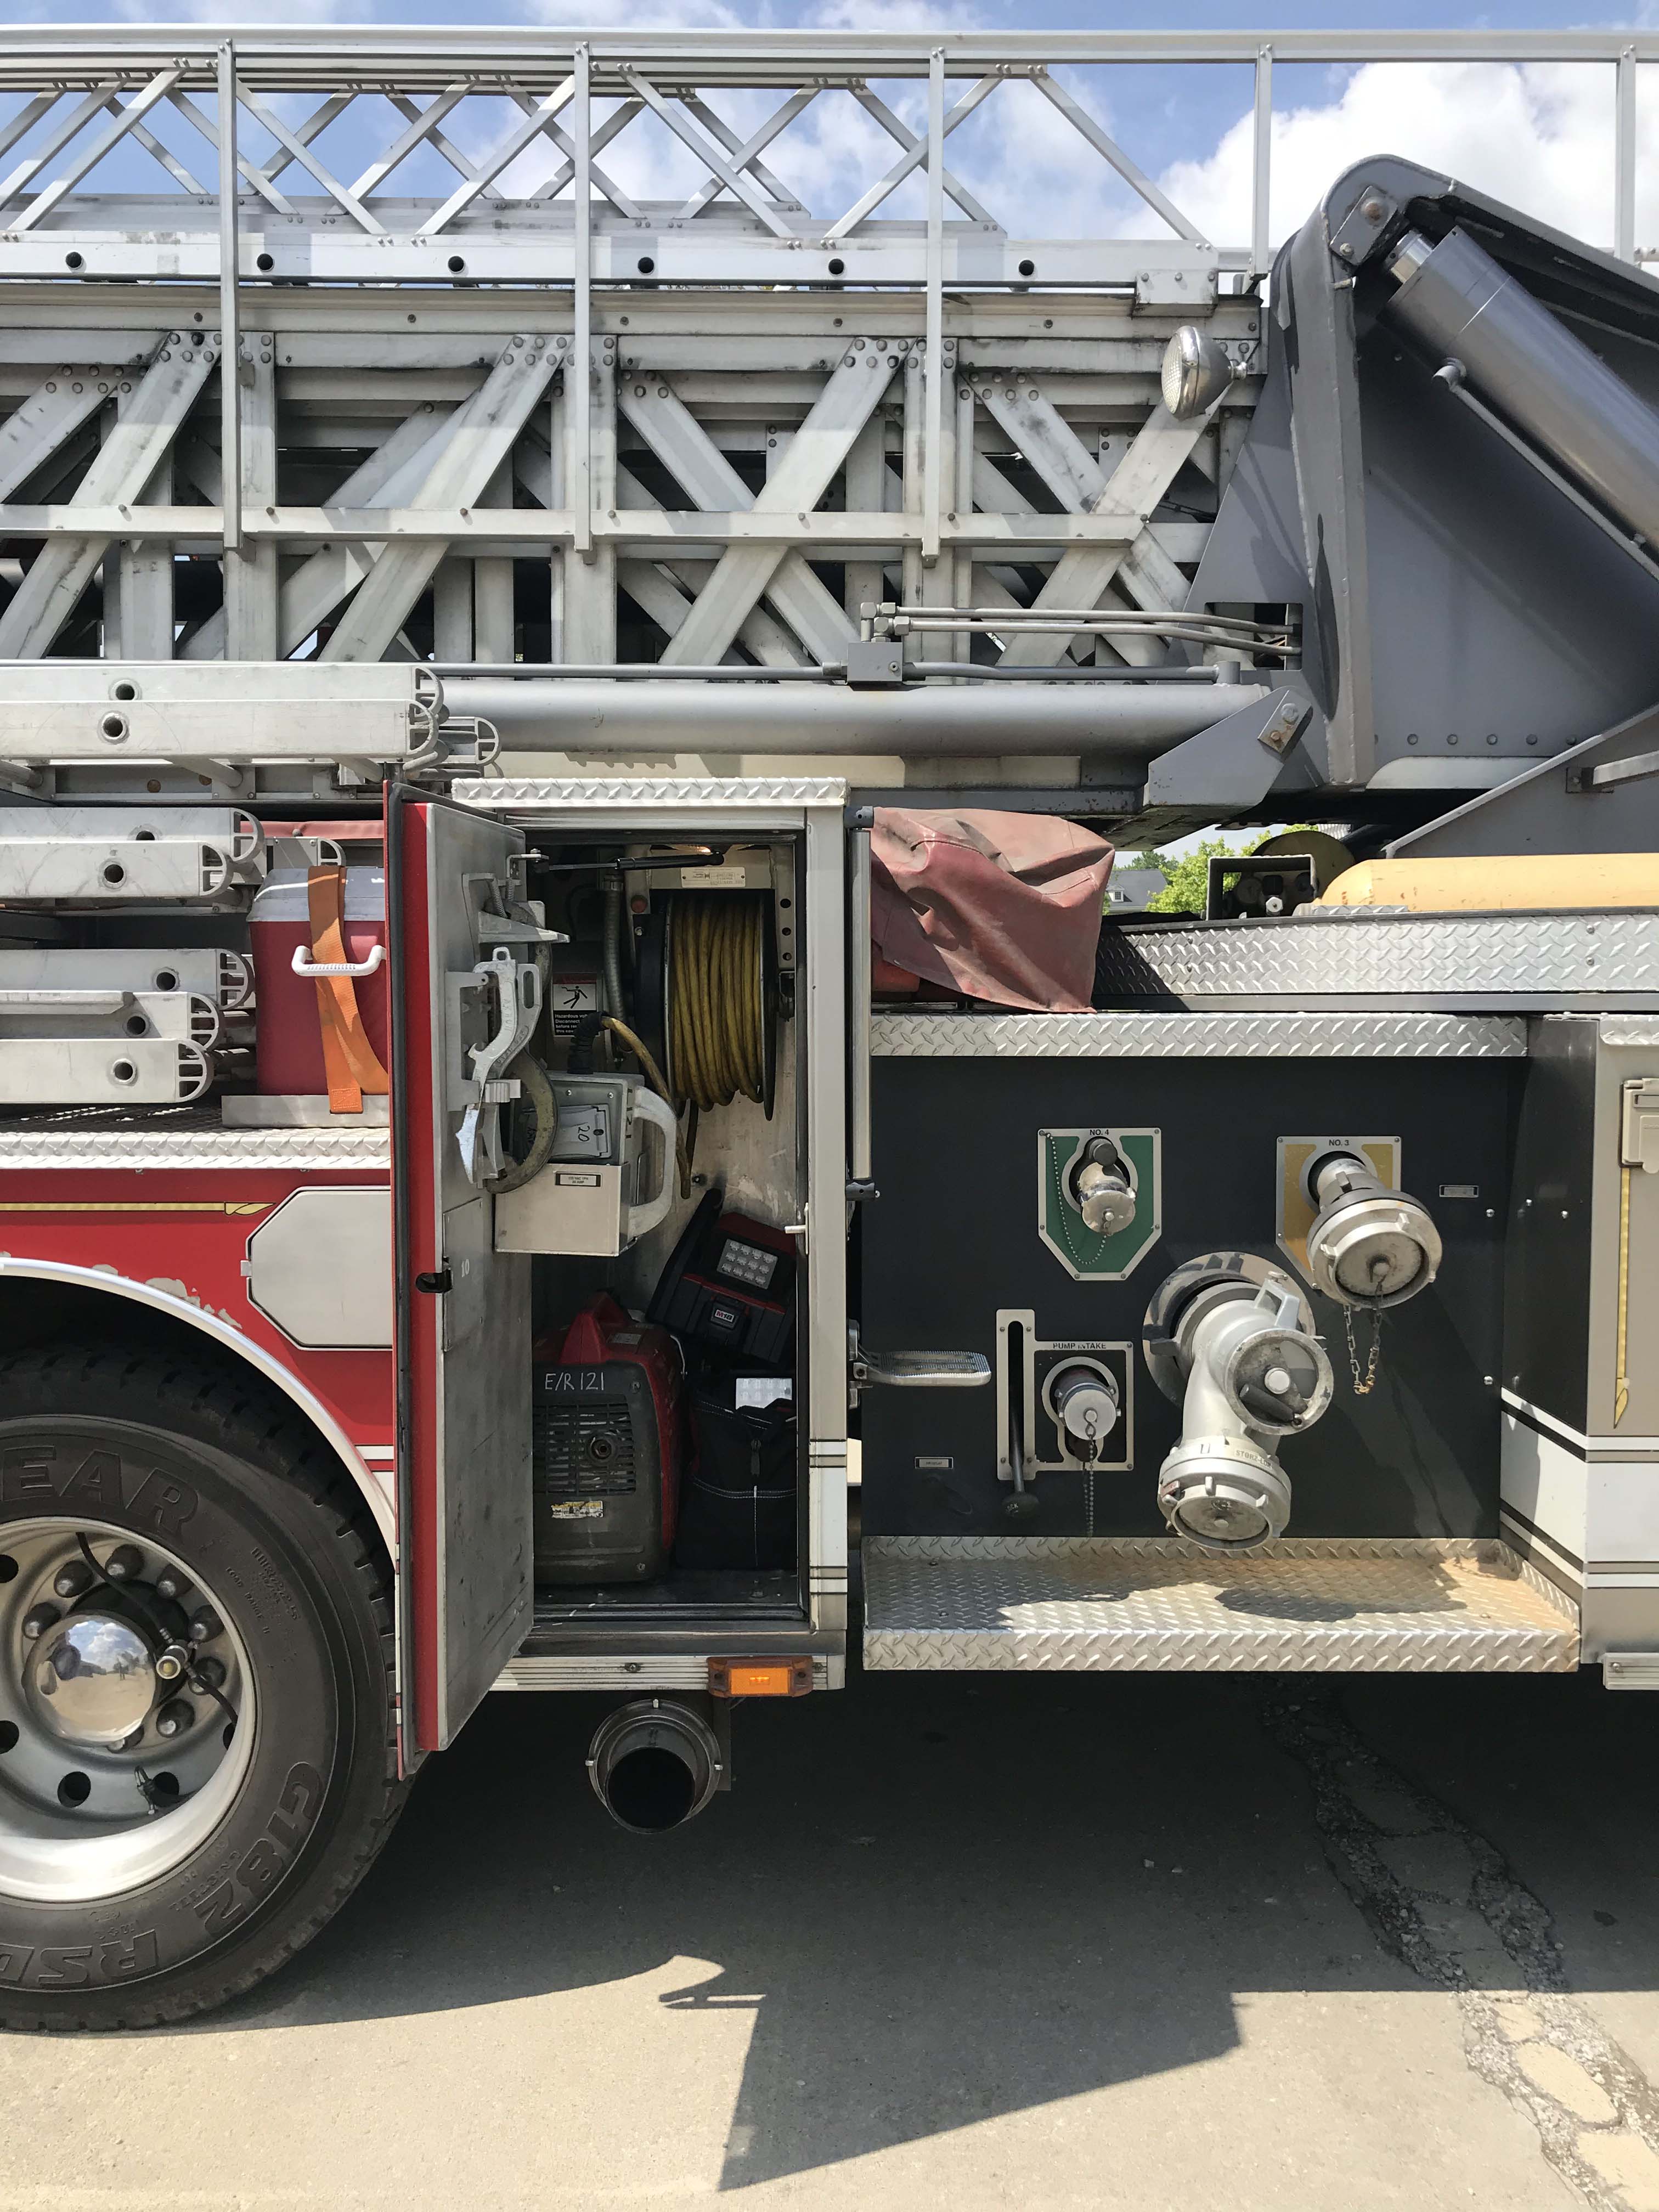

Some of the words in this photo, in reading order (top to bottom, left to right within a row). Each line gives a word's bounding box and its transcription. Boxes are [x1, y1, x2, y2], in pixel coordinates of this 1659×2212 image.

[578, 1125, 590, 1142] 20
[461, 1259, 470, 1278] 10
[715, 1310, 733, 1321] M18
[545, 1372, 575, 1391] E/R
[580, 1372, 604, 1391] 121
[193, 1761, 325, 1938] G182
